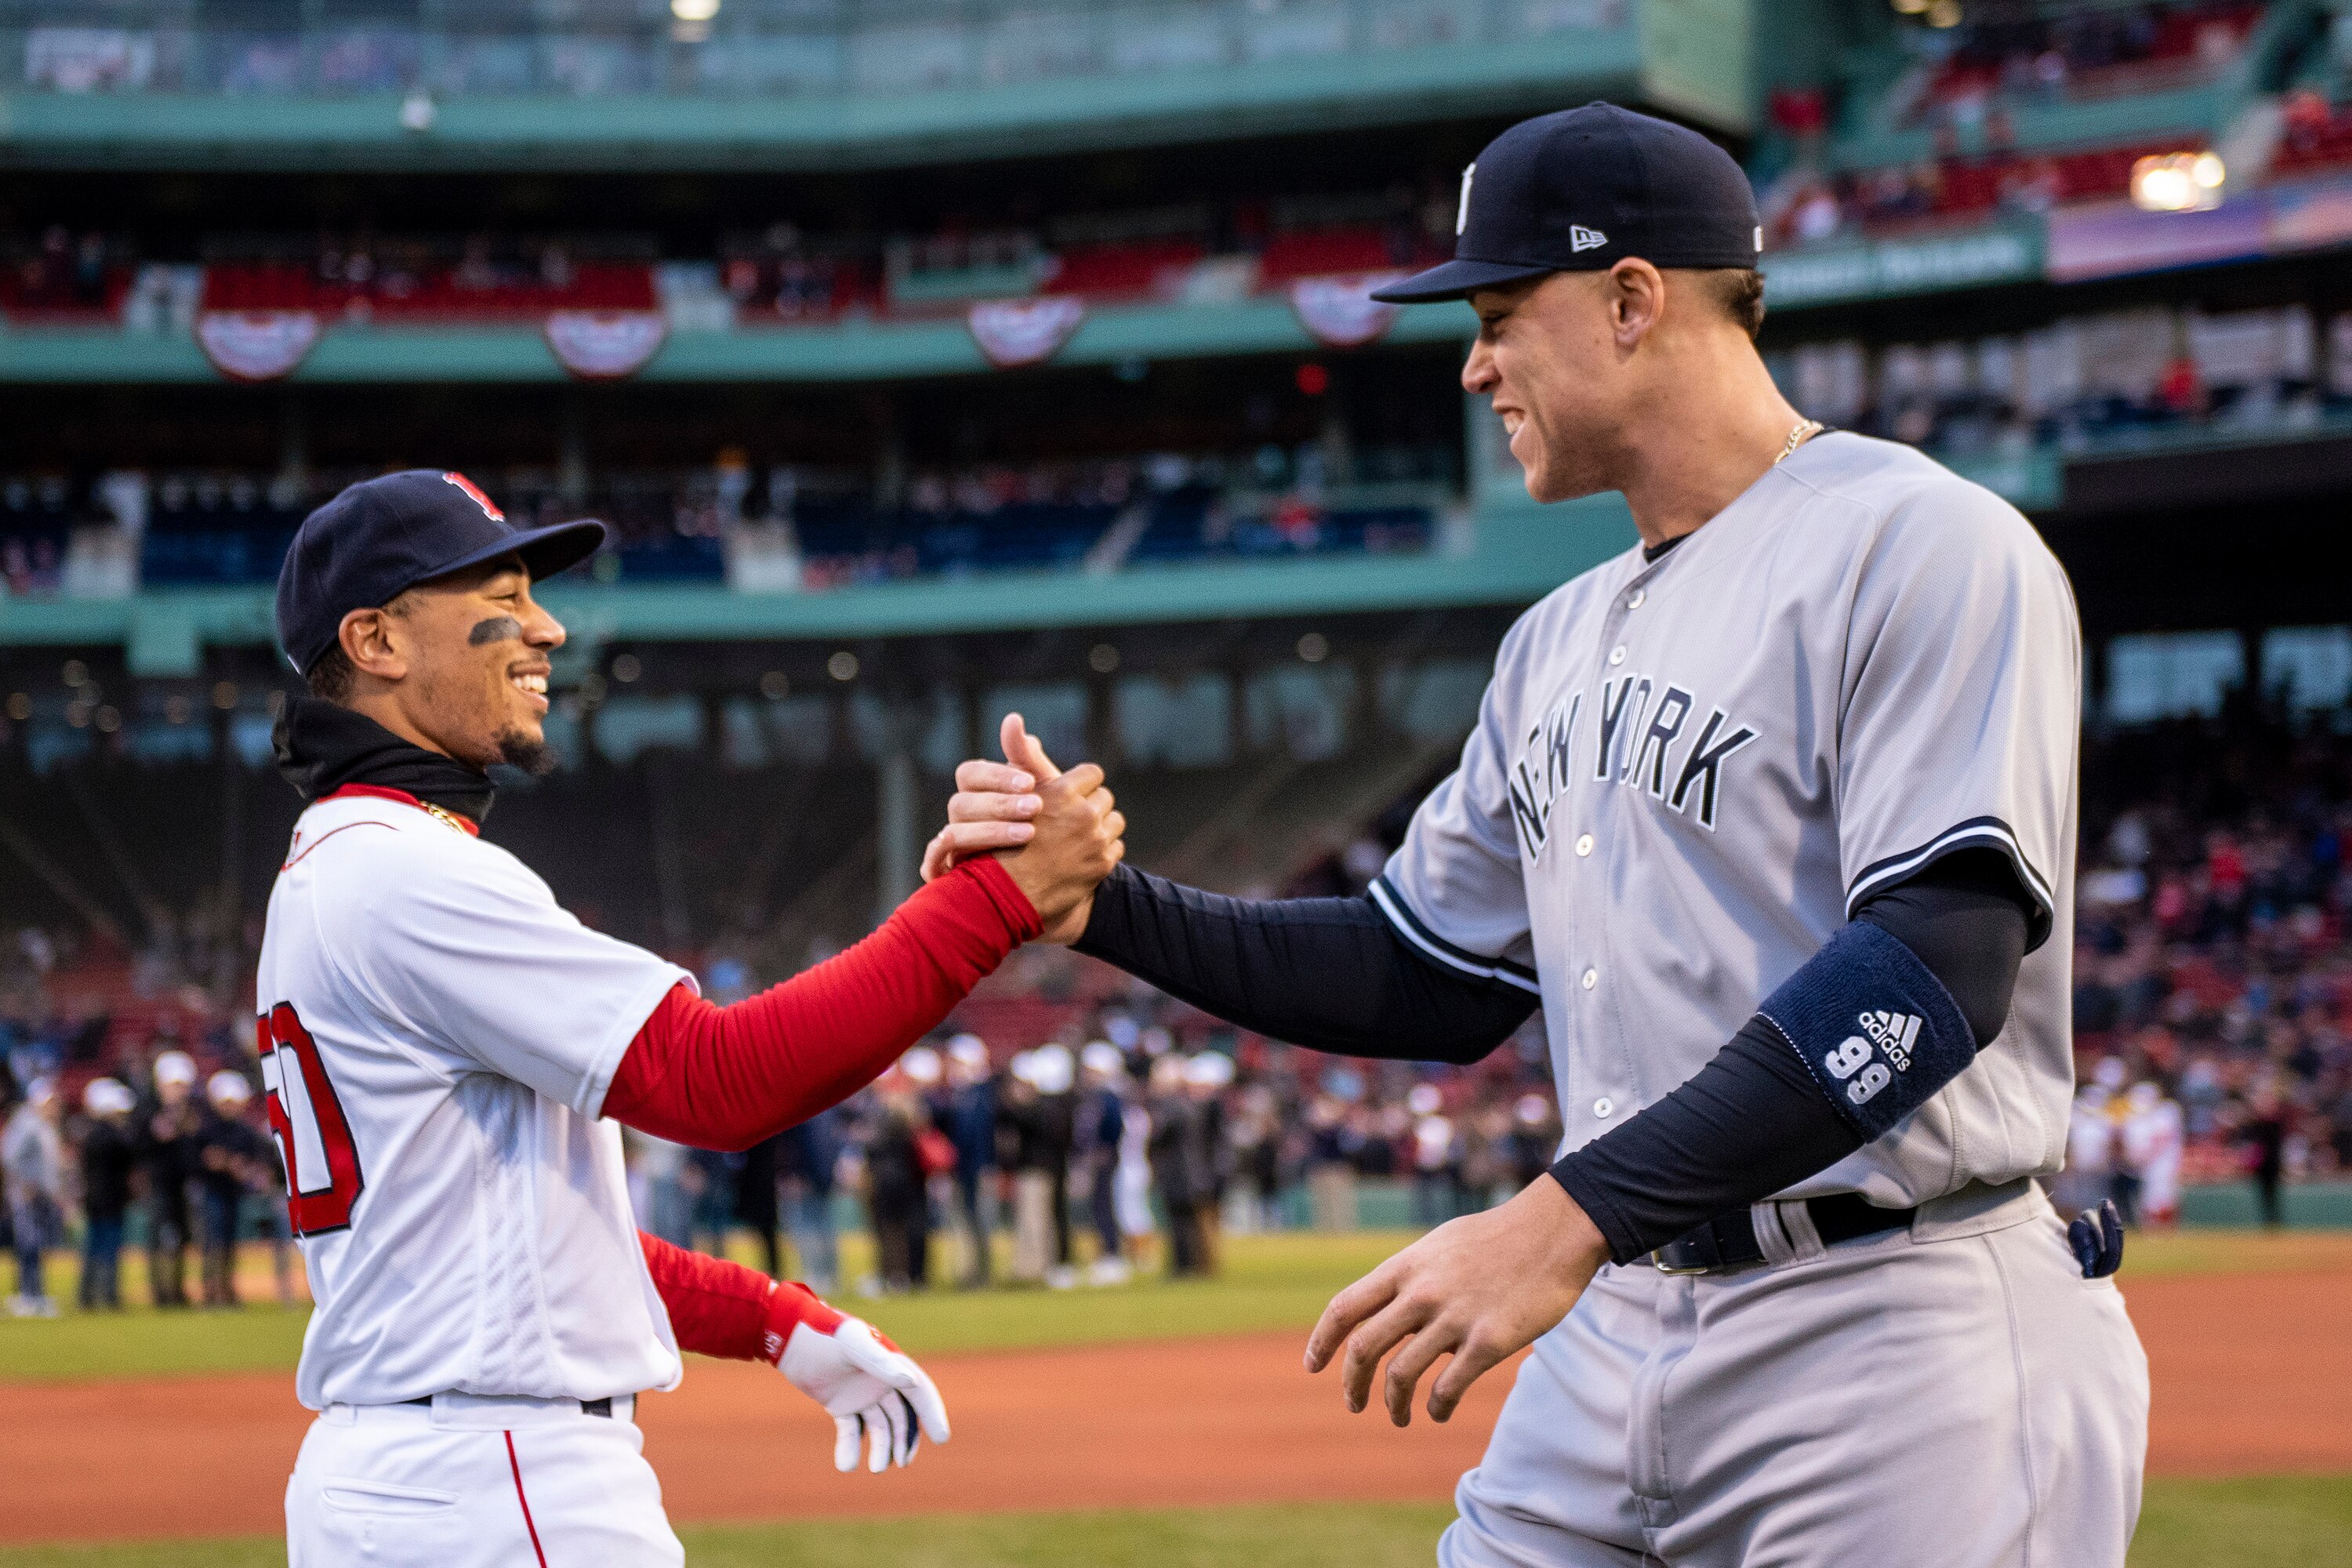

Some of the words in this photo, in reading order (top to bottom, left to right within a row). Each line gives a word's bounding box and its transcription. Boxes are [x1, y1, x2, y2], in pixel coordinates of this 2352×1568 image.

[1508, 690, 1584, 867] NEW
[1593, 673, 1762, 832] YORK
[1824, 1036, 1891, 1105] 99
[1859, 1011, 1912, 1073] adidas
